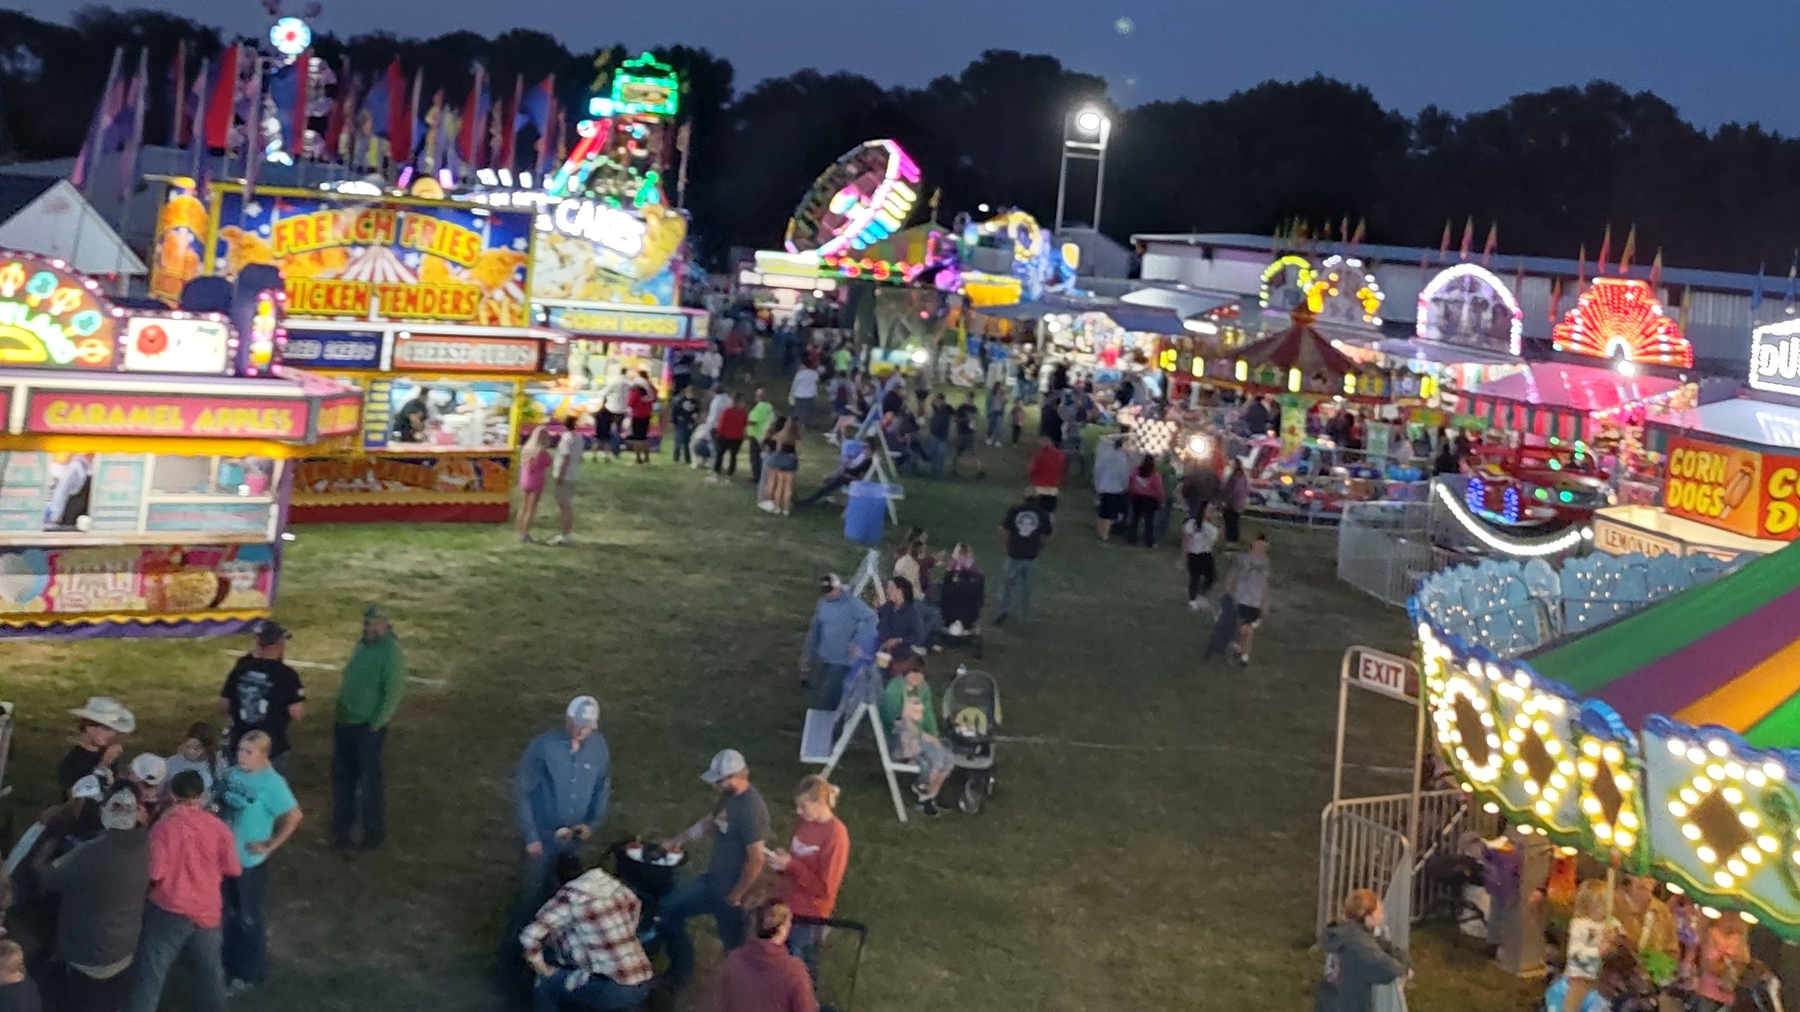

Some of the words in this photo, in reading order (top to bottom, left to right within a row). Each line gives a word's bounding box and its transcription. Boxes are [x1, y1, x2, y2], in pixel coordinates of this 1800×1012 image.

[274, 208, 394, 253] FRENCH
[403, 213, 480, 264] FRIES
[284, 280, 370, 312] HICKEN
[377, 284, 477, 318] TENDERS
[1758, 336, 1800, 379] DU
[45, 400, 184, 428] CARAMEL
[193, 407, 293, 432] APPLES
[1669, 447, 1729, 484] CORN
[1666, 478, 1727, 517] DOGS
[1362, 657, 1402, 688] EXIT
